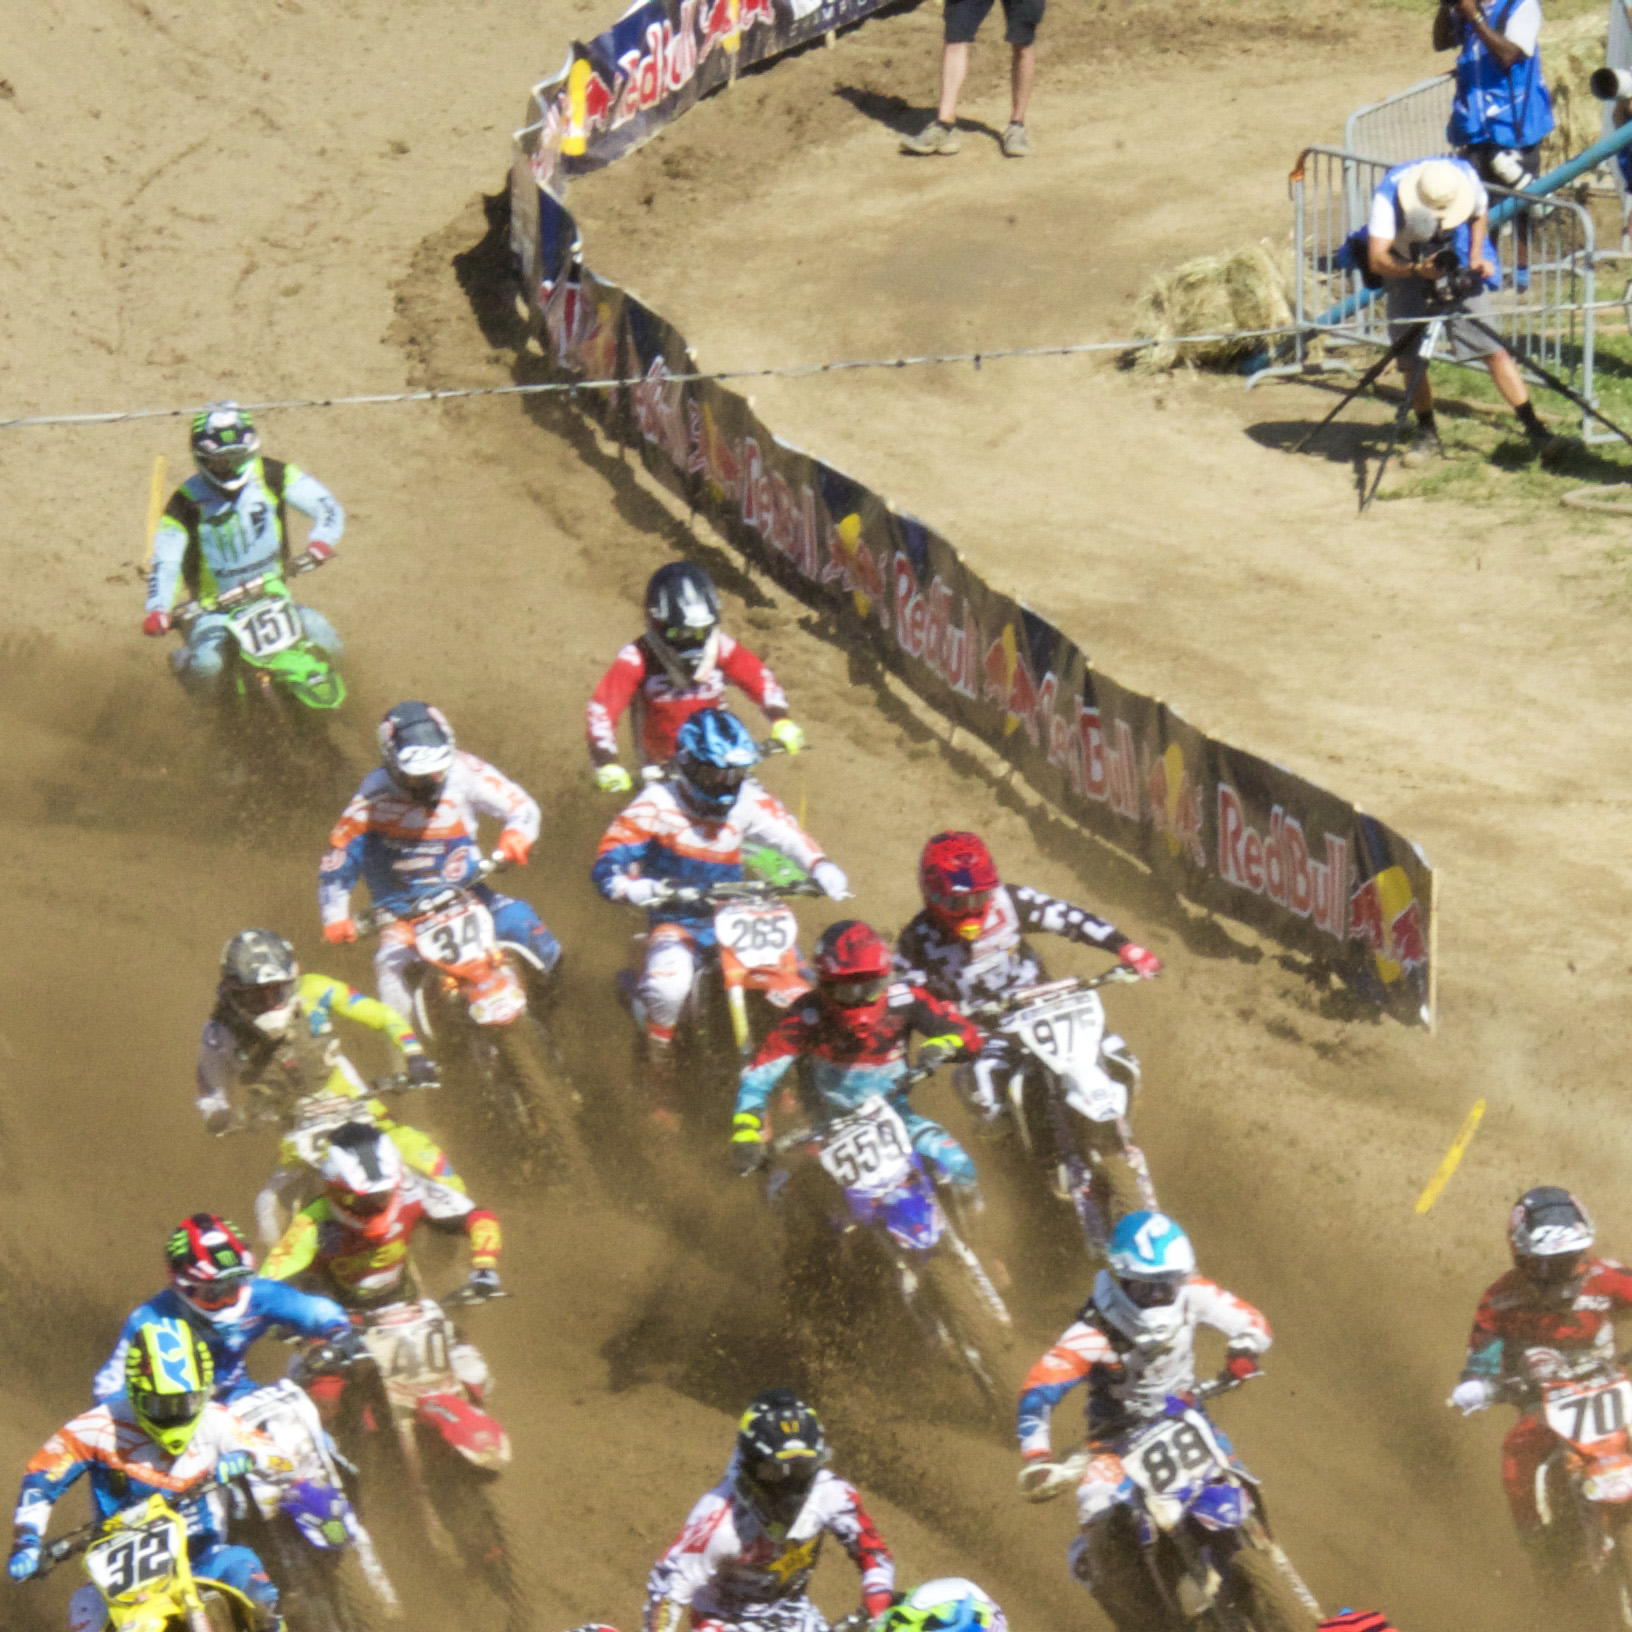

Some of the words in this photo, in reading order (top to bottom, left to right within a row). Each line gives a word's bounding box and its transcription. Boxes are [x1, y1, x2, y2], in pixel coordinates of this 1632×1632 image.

[241, 602, 297, 653] 151
[731, 915, 788, 951] 265
[831, 1119, 907, 1185] 559
[1560, 1389, 1624, 1444] 70
[1142, 1426, 1214, 1491] 88
[105, 1529, 172, 1601] 32
